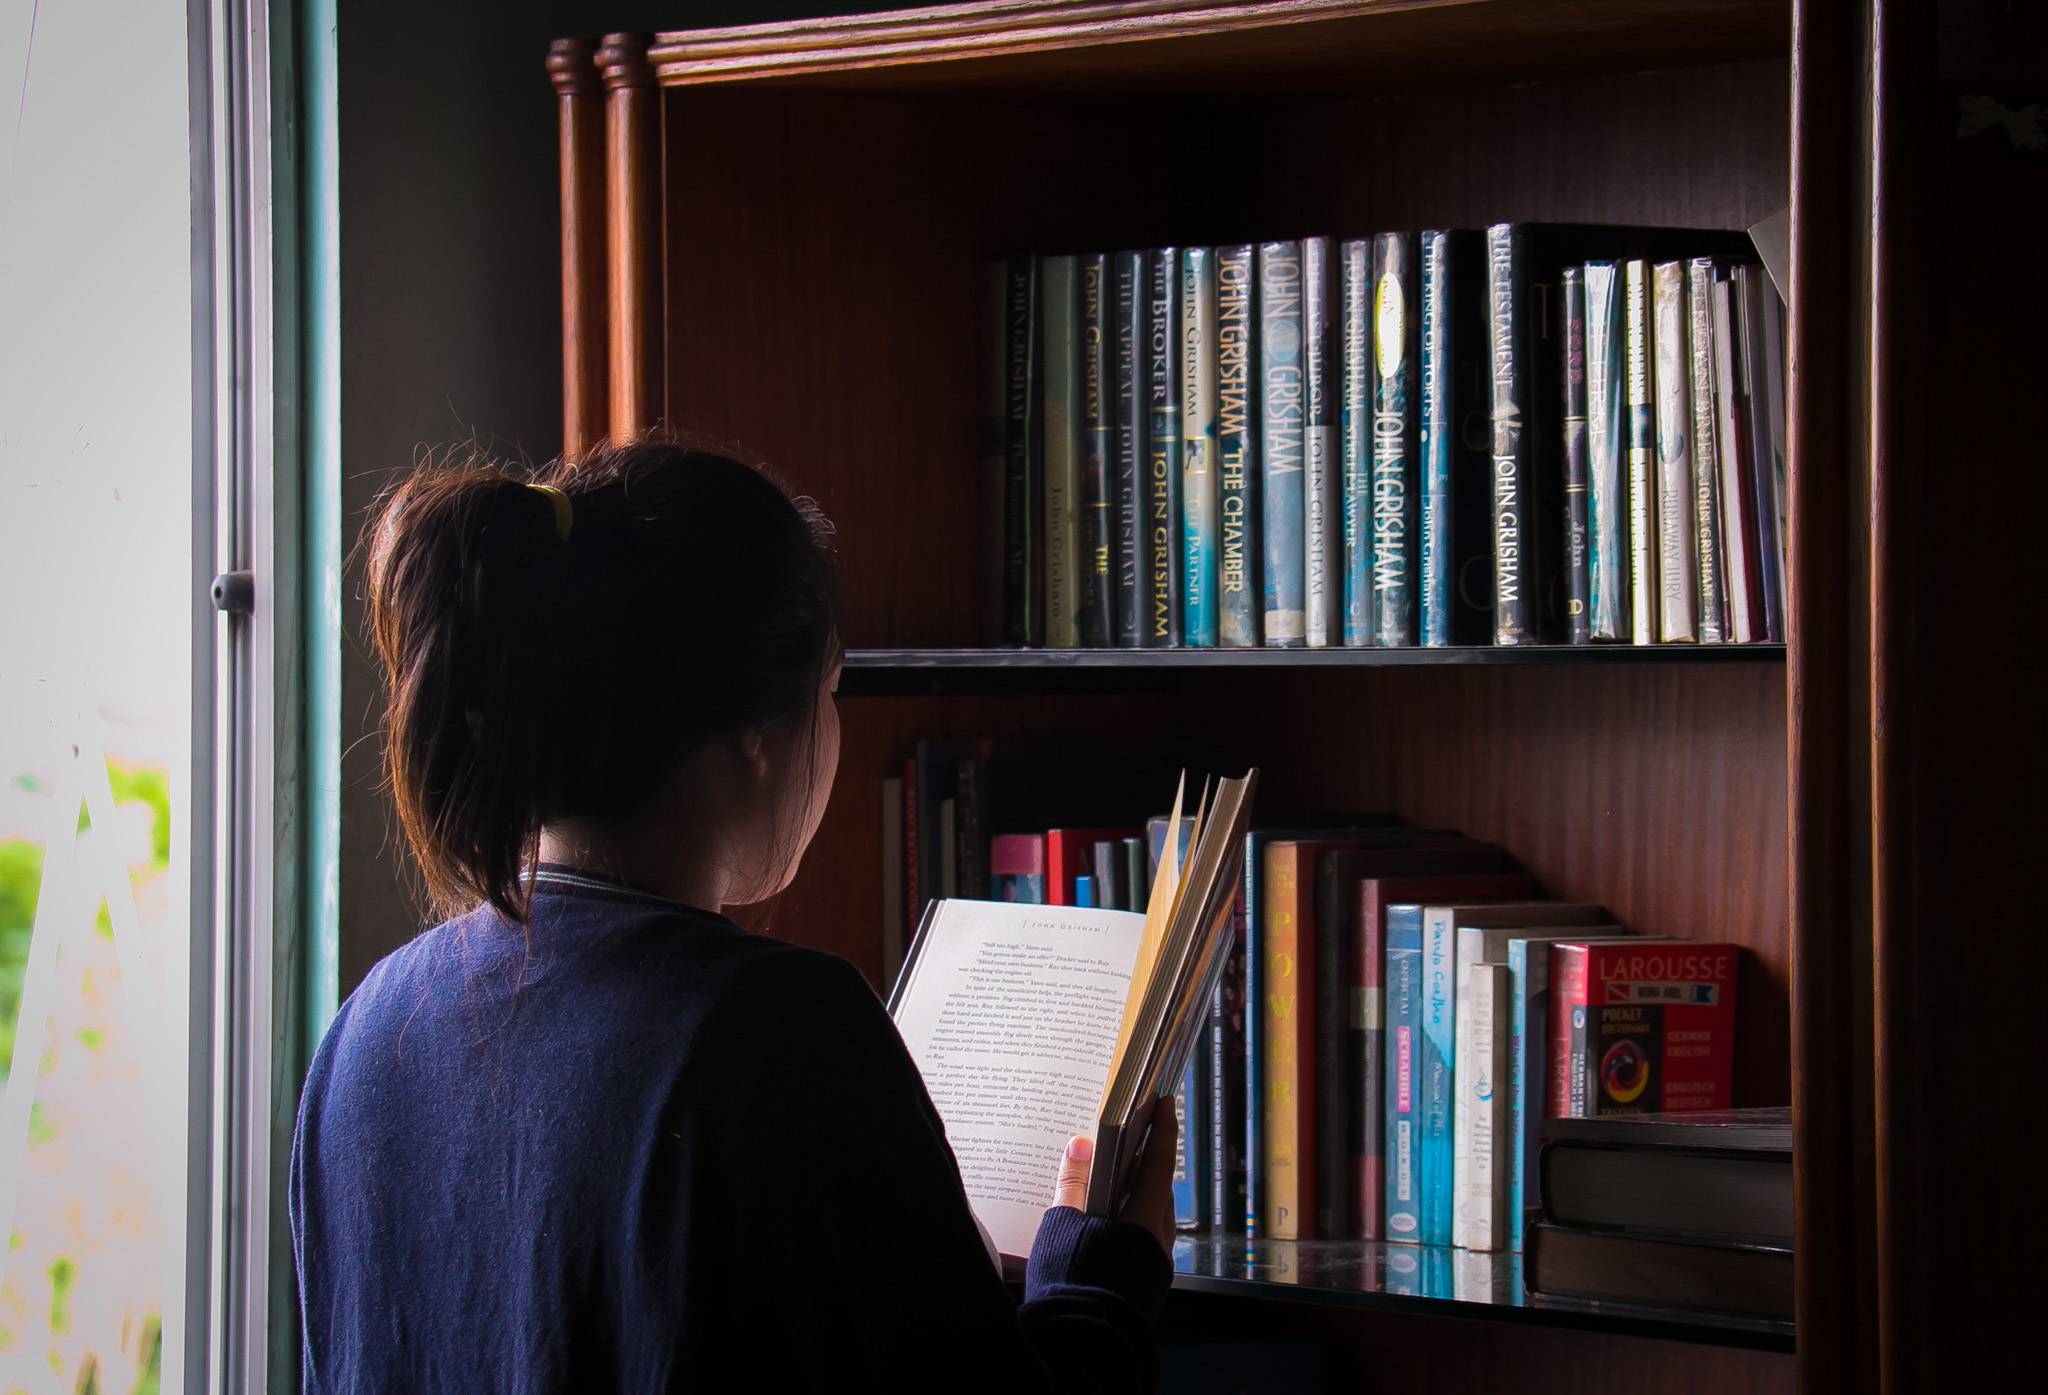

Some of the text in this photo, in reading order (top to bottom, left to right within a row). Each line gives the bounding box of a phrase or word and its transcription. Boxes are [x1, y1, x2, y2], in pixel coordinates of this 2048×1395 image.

[1185, 269, 1197, 319] JOHN
[1344, 259, 1365, 314] JOHN
[1424, 283, 1435, 325] KING
[1085, 264, 1101, 418] JOHN GRISHAM
[1187, 327, 1201, 417] GRISHAM
[1265, 254, 1303, 476] JOHN GRISHAM
[1345, 319, 1365, 410] GRISHAM
[1424, 331, 1435, 354] OF
[1569, 317, 1584, 385] FORD
[1424, 363, 1435, 417] TORTS
[1492, 236, 1519, 603] THE TESTAMENT JOHN GRISHAM
[1120, 269, 1134, 587] THE APPEAL JOHN GRISHAM
[1152, 262, 1169, 637] THE BROKER JOHN GRISHAM
[1220, 257, 1248, 595] JOHN GRISHAM THE CHAMBER
[1310, 436, 1322, 491] JOHN
[1374, 409, 1404, 591] JOHN GRISHAM
[1423, 503, 1434, 540] John
[1698, 480, 1711, 521] JOHN
[1051, 488, 1062, 618] John Grisham
[1096, 544, 1108, 576] THE
[1188, 535, 1201, 606] PARTNER
[1311, 500, 1322, 596] GRISHAM
[1423, 542, 1434, 607] Grisham
[1572, 521, 1585, 568] John
[1663, 490, 1681, 600] RUNAWAY JURY
[1699, 527, 1713, 597] GRISHAM
[1060, 924, 1100, 932] GRISHAM
[970, 967, 993, 975] checking
[1400, 960, 1409, 1015] OFFICIAL
[1432, 920, 1446, 1024] Paulo Coelho
[1599, 956, 1728, 981] LAROUSSE
[1266, 911, 1295, 1103] POWER
[1602, 1007, 1643, 1022] POCKET
[1277, 1206, 1289, 1226] P
